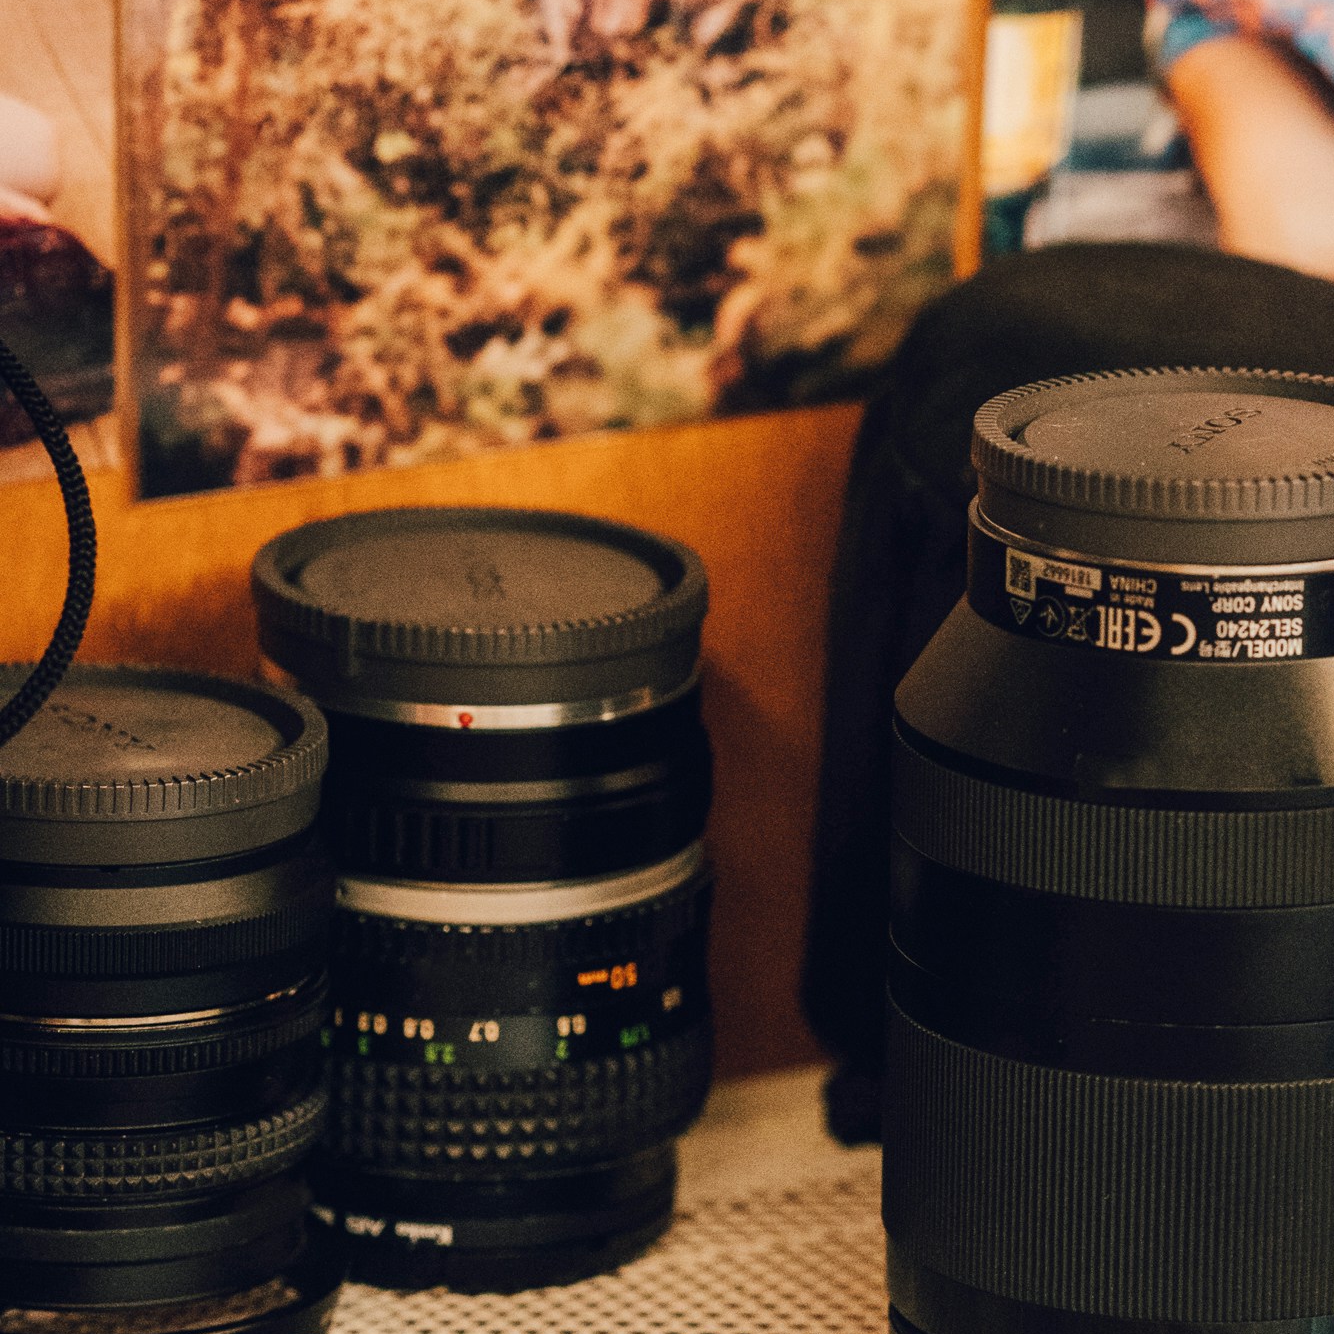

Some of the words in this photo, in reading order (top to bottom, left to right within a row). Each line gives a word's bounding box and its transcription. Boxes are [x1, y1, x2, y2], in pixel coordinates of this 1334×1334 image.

[1109, 574, 1157, 594] CHINA
[1180, 580, 1210, 593] Lens
[1209, 595, 1255, 614] CORP.
[1260, 594, 1304, 614] SONY
[1216, 617, 1303, 639] SEL24240
